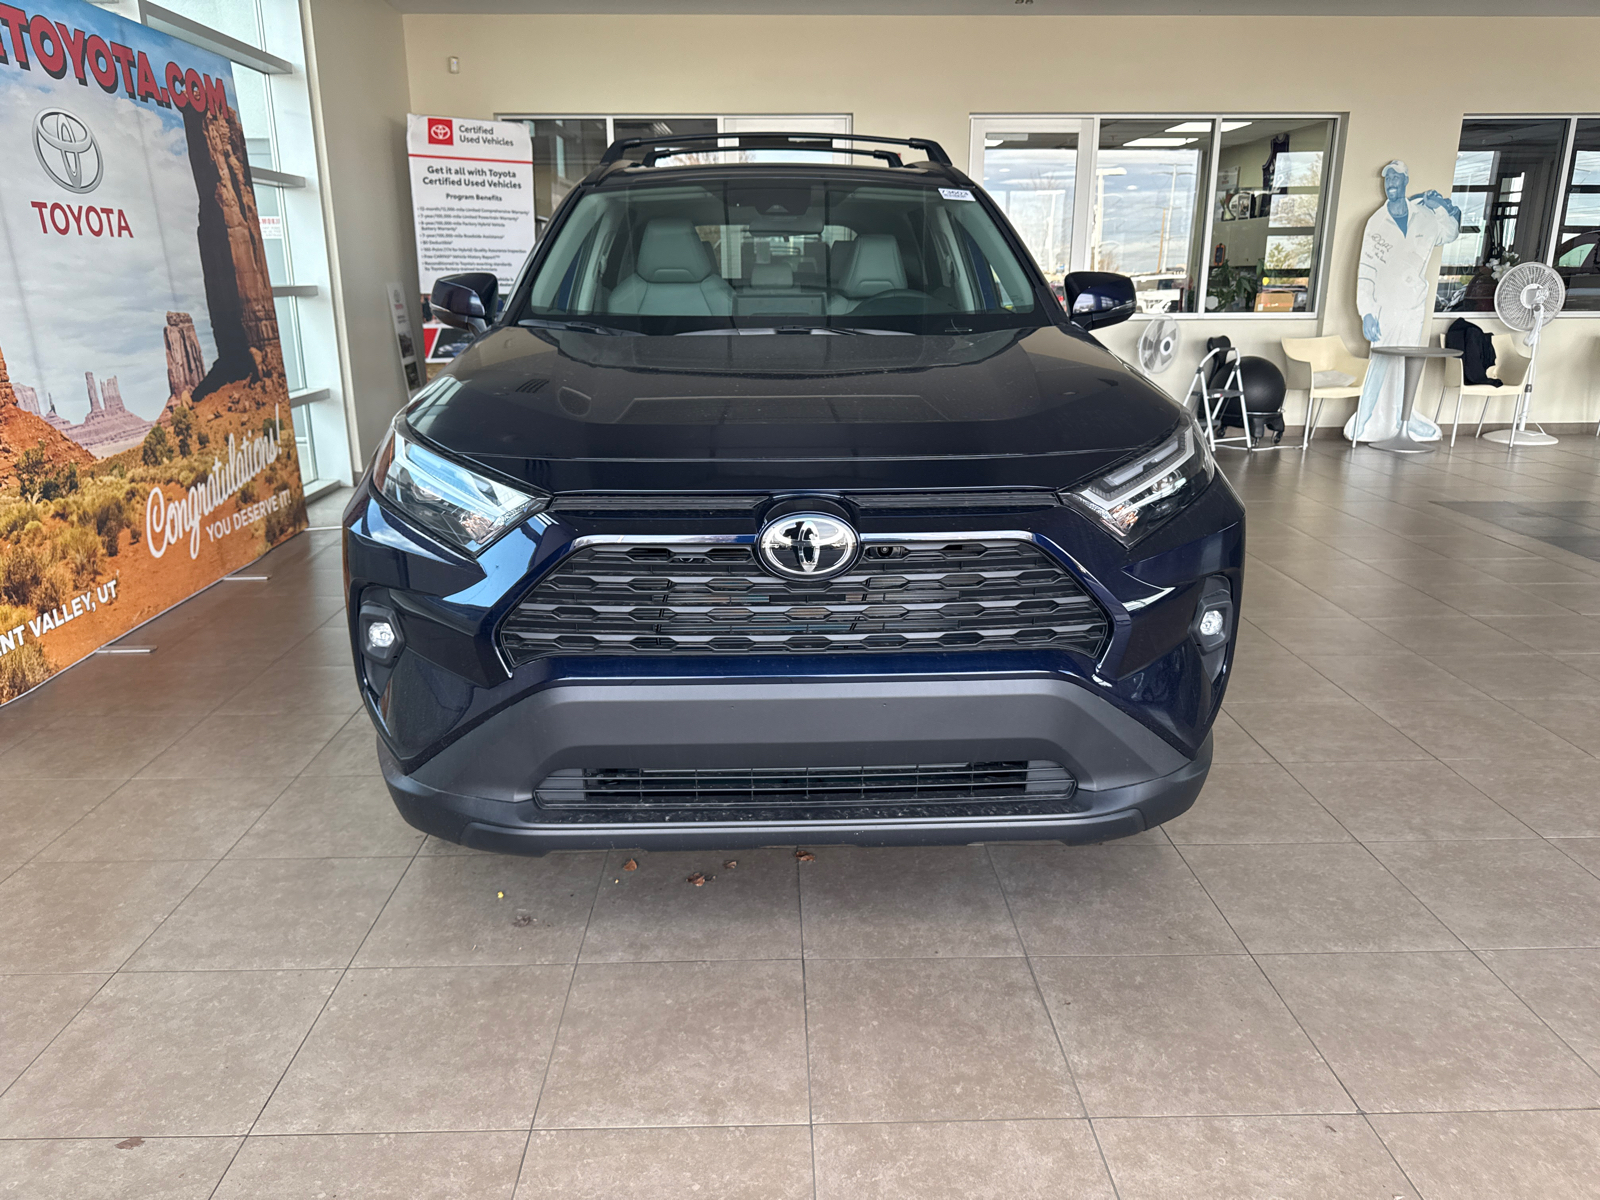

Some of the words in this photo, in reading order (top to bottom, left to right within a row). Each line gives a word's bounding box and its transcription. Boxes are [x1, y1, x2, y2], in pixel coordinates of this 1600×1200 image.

[459, 125, 494, 135] Certified
[459, 135, 480, 143] Used
[482, 136, 514, 147] Vehicles
[427, 166, 444, 174] Get
[454, 167, 466, 176] all
[467, 168, 487, 177] with
[488, 169, 516, 179] Toyota
[423, 177, 462, 186] Certified
[464, 179, 486, 187] Used
[487, 180, 522, 189] Vehicles
[446, 193, 475, 201] Program
[476, 194, 502, 202] Benefits
[31, 201, 134, 239] TOYOTA
[146, 403, 282, 560] Congratulations!
[206, 516, 231, 542] YOU
[233, 496, 278, 530] DESERVE
[279, 489, 292, 505] IT!
[0, 625, 25, 657] NT
[28, 591, 97, 638] VALLEY,
[97, 579, 117, 604] UT
